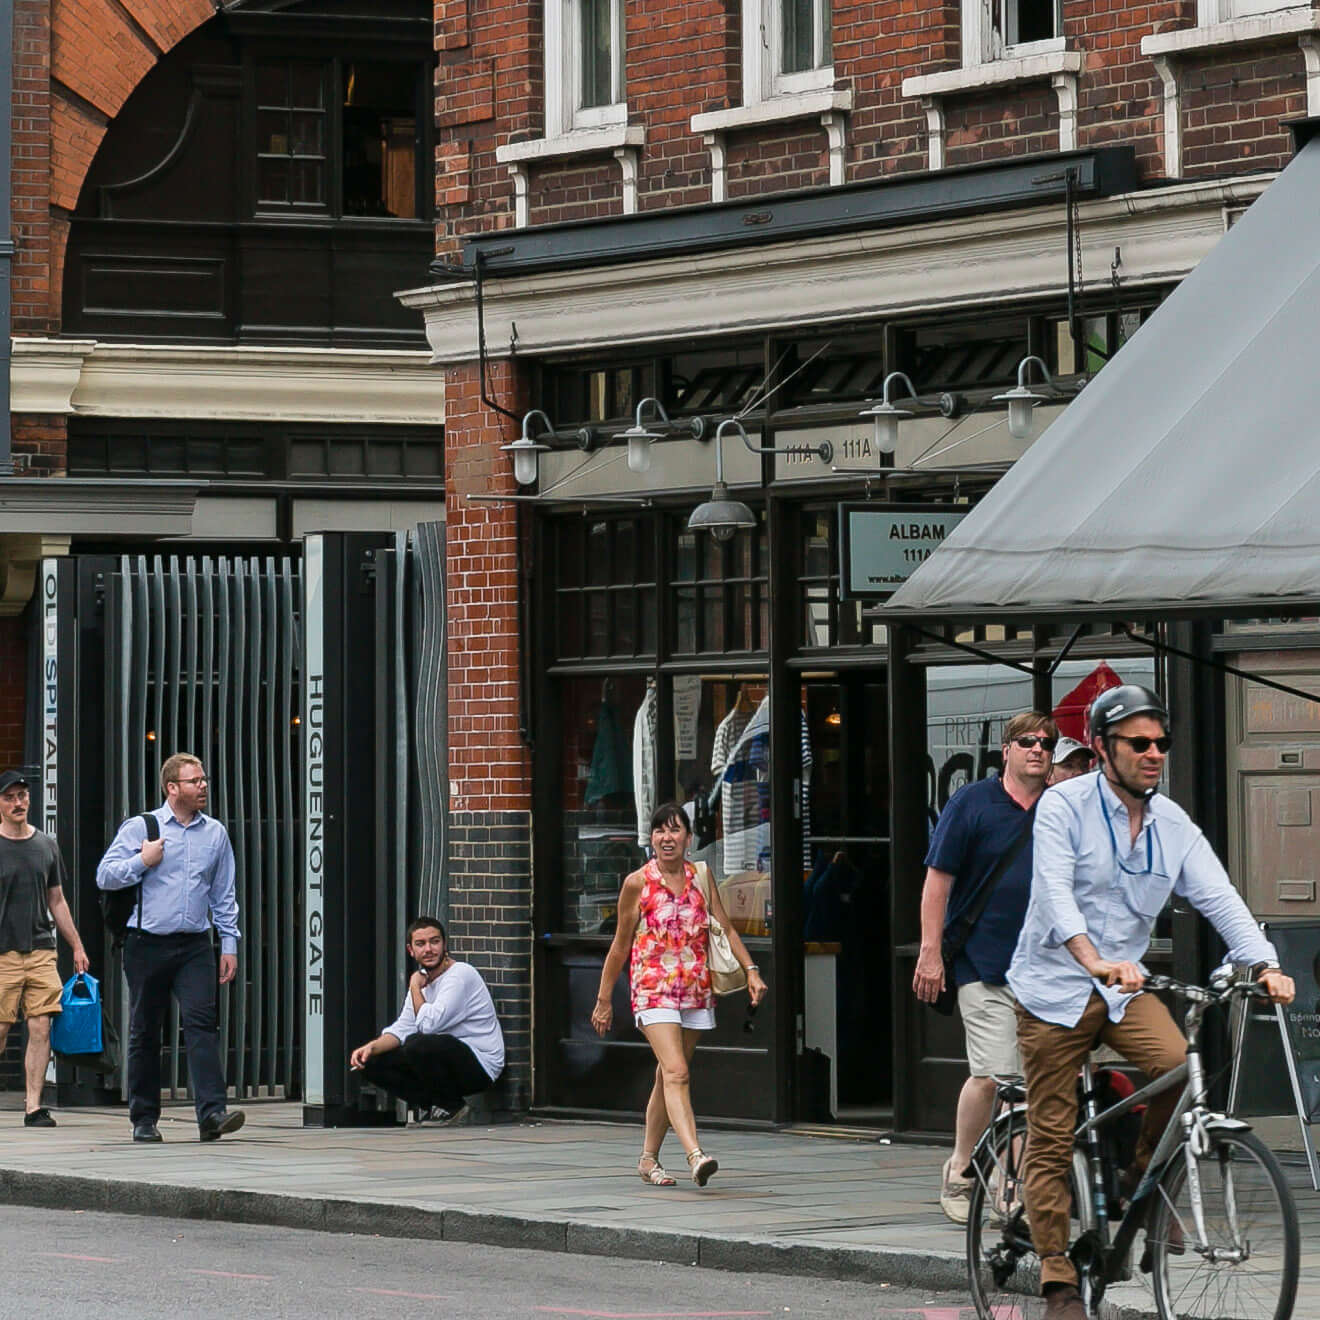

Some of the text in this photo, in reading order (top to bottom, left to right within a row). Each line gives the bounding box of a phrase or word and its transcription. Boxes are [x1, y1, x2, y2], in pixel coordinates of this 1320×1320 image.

[842, 438, 872, 459] 111A
[889, 524, 945, 540] ALBAM
[45, 574, 57, 647] OLD
[309, 675, 323, 1016] HUGUENOT GATE
